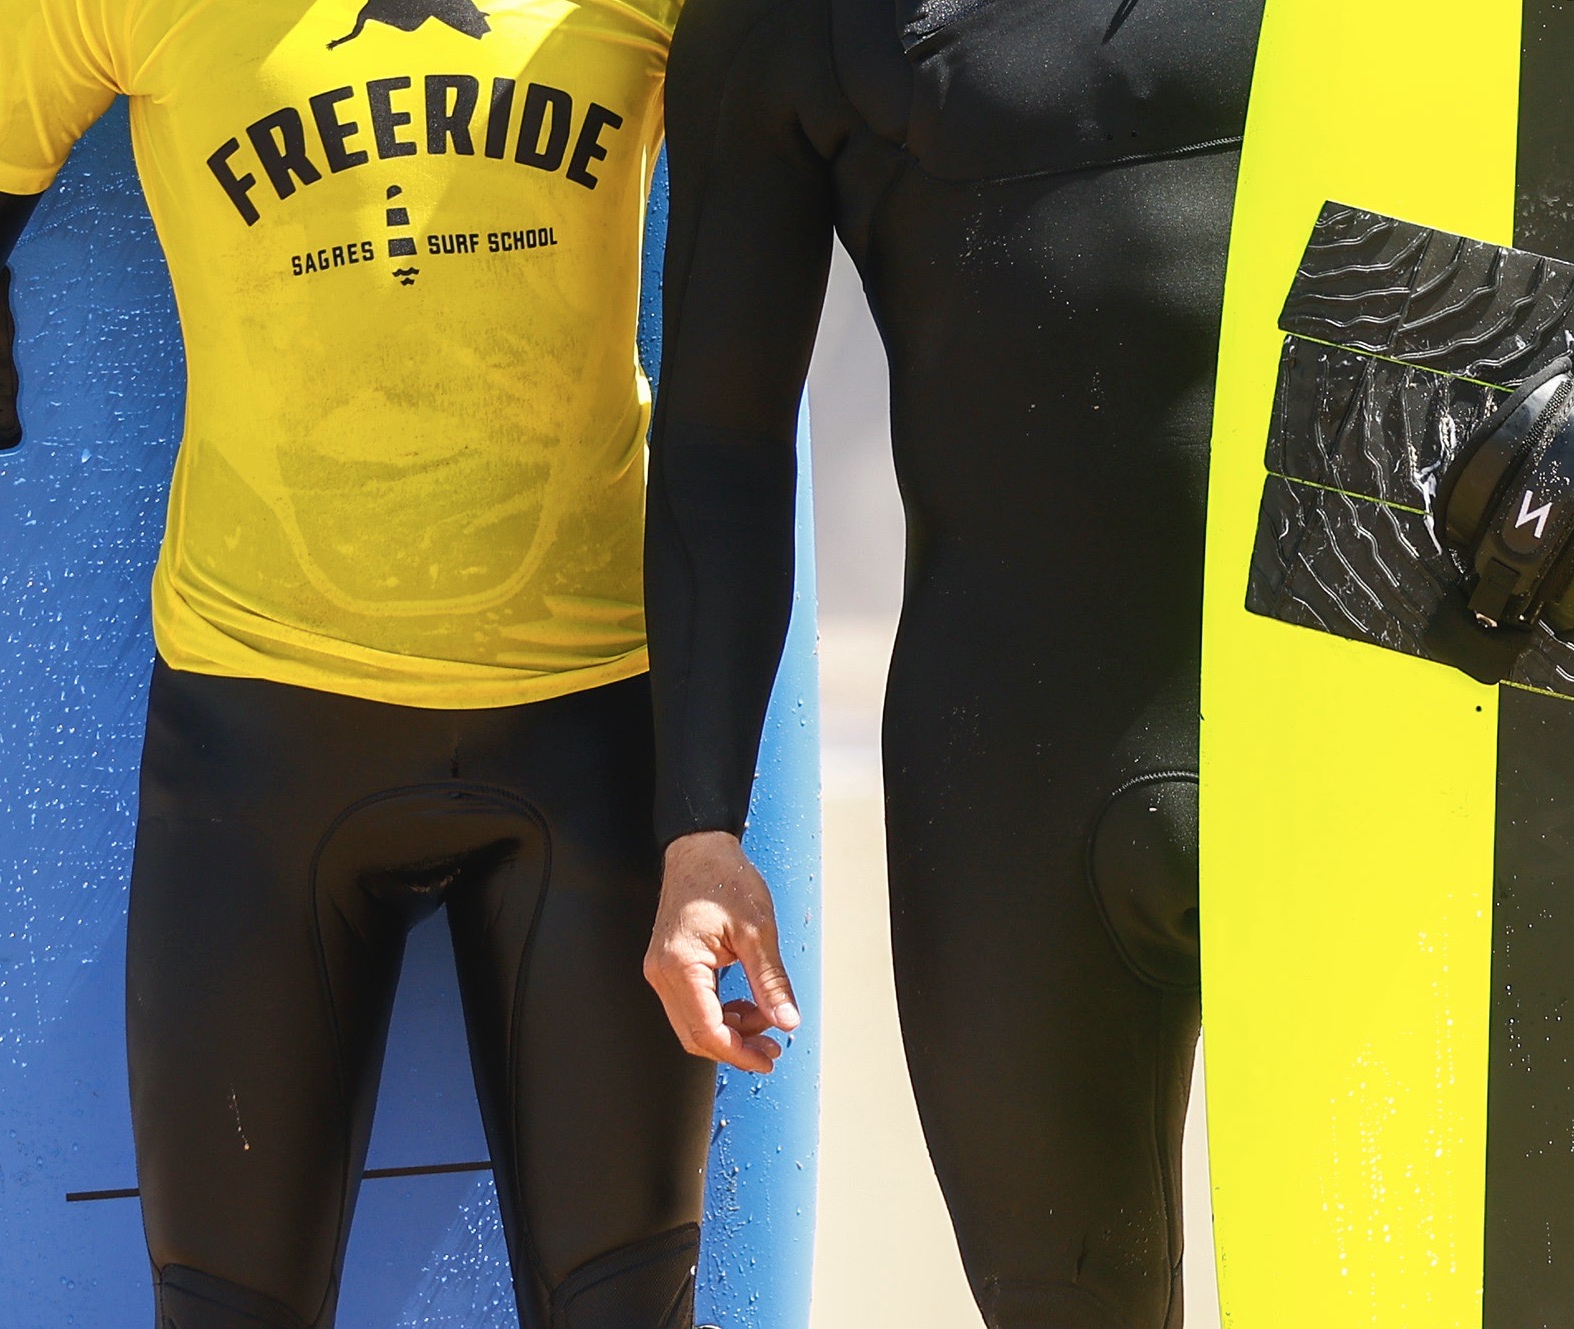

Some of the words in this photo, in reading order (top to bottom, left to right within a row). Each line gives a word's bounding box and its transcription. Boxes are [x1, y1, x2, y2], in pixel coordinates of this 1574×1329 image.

[206, 74, 624, 227] FREERIDE
[291, 241, 375, 276] SAGRES
[427, 234, 480, 254] SURF
[488, 227, 558, 253] SCHOOL
